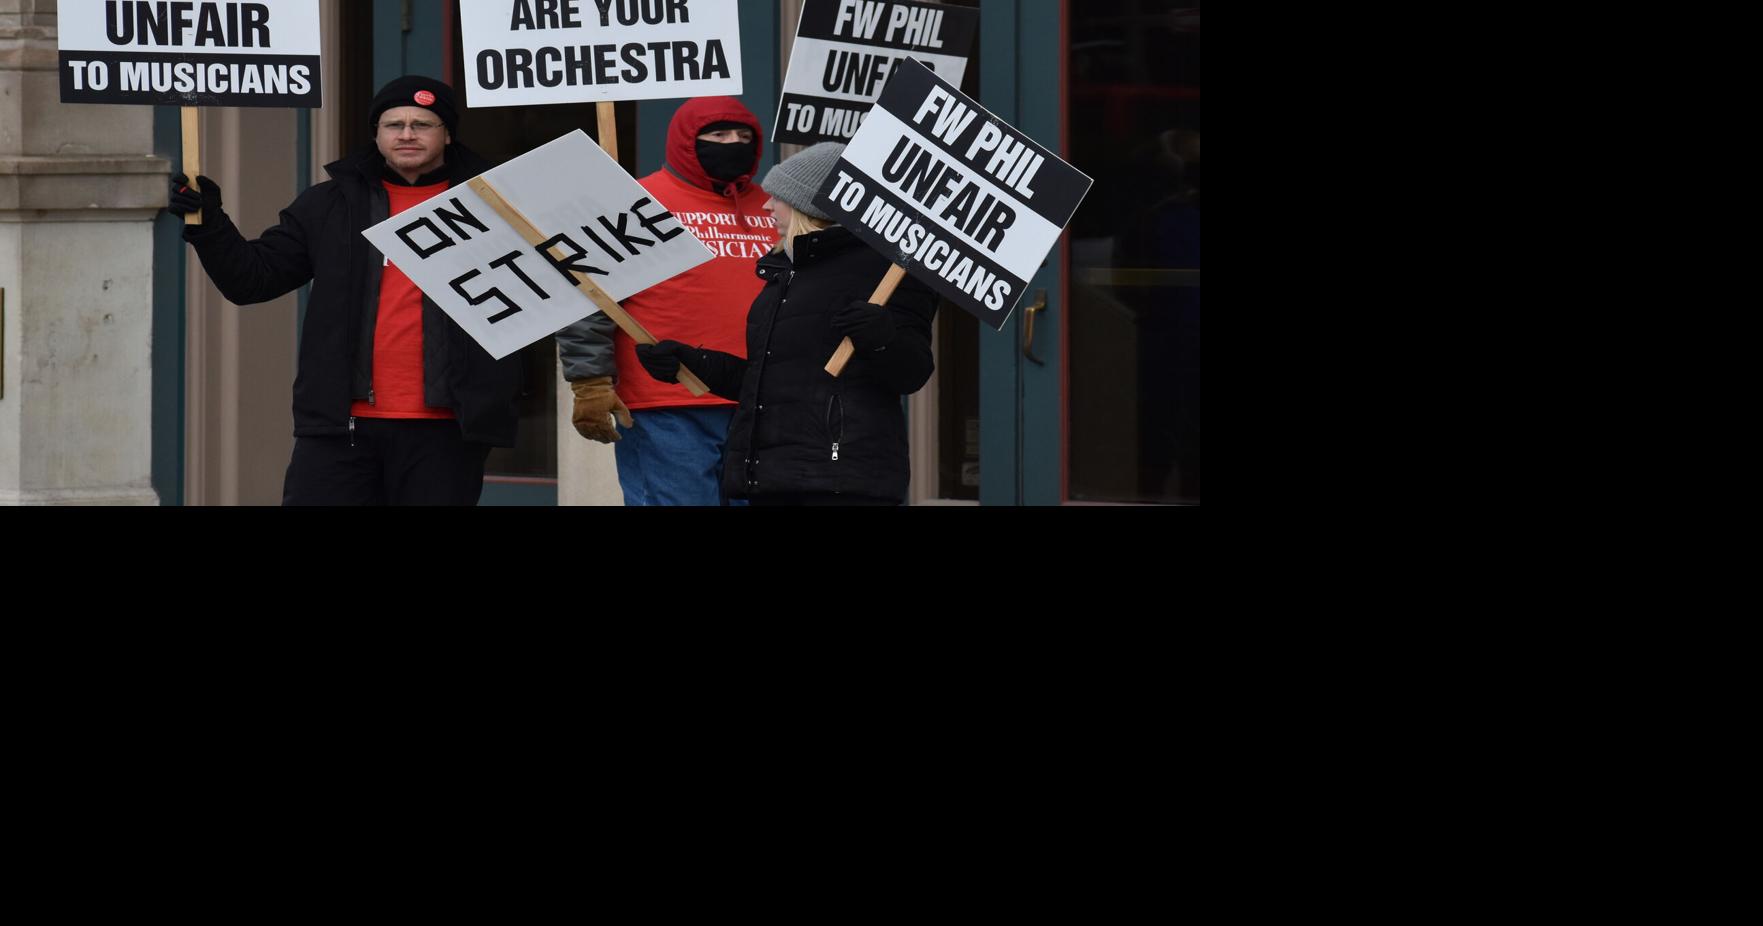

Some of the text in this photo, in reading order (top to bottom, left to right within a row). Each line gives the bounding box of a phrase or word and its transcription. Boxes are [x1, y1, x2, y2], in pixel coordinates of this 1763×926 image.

[104, 0, 271, 48] UNFAIR
[510, 0, 689, 31] ARE YOUR
[833, 0, 944, 48] FW PHIL
[68, 60, 311, 95] TO MUSICIANS
[476, 39, 731, 90] ORCHESTRA
[785, 102, 815, 133] TO
[913, 84, 978, 147] FW
[964, 121, 1045, 199] PHIL
[881, 134, 1017, 253] UNFAIR
[394, 197, 490, 260] ON
[670, 211, 737, 226] UPPORT
[828, 170, 1012, 311] TO MUSICIANS
[448, 196, 685, 324] STRIKE
